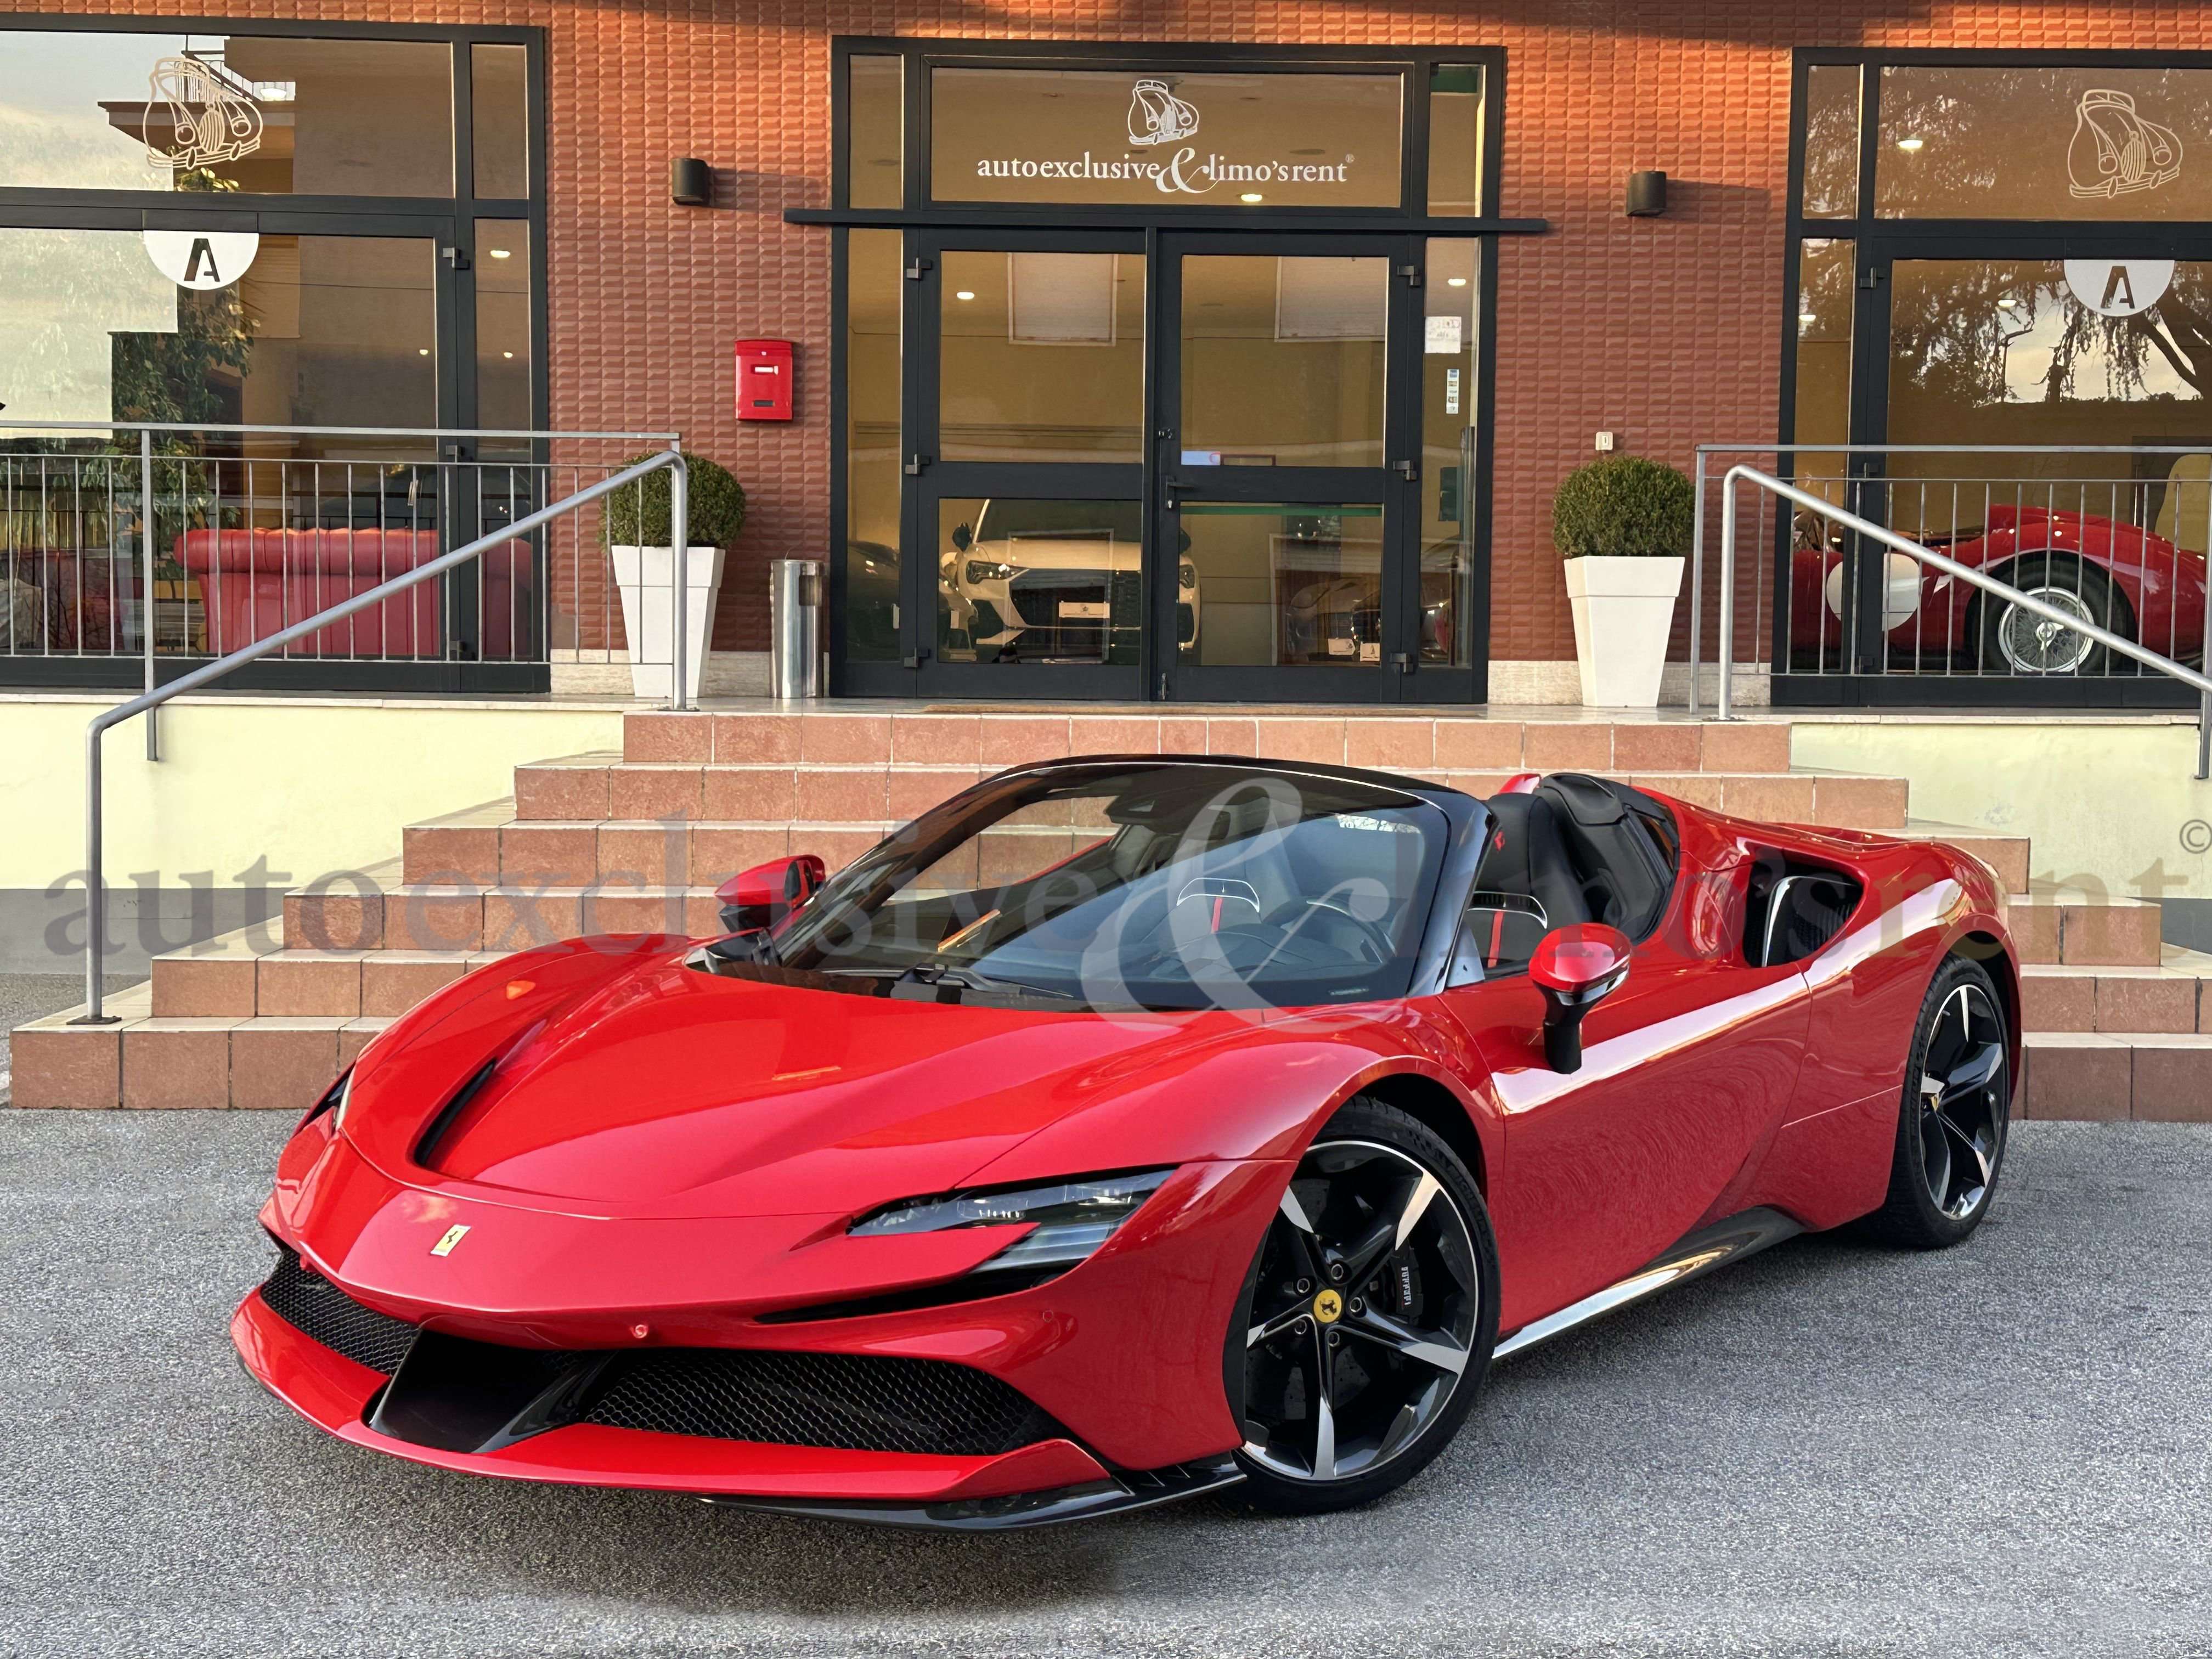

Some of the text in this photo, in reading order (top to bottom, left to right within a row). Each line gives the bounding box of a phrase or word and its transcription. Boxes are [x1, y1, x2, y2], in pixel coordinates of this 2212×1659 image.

[977, 151, 1160, 179] autoexclusive
[1155, 147, 1220, 194] &
[184, 238, 220, 281] A
[2100, 266, 2135, 308] A
